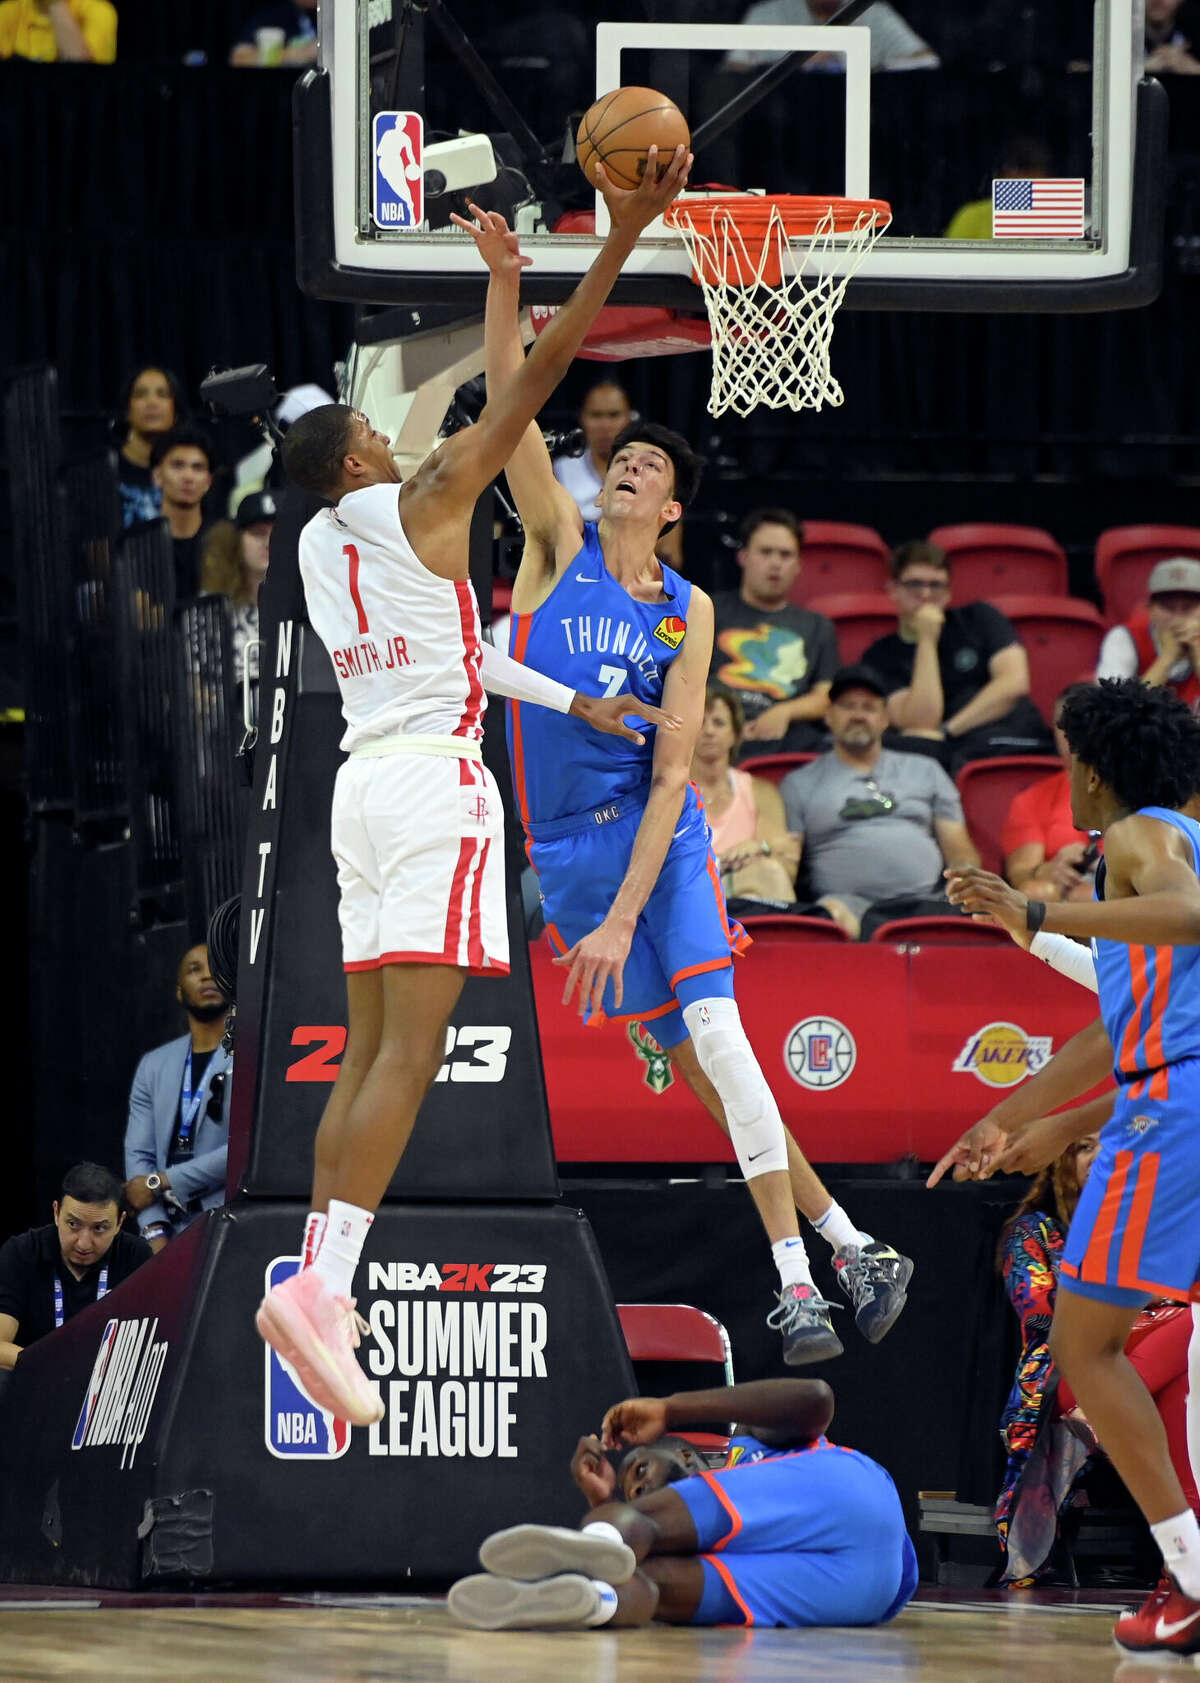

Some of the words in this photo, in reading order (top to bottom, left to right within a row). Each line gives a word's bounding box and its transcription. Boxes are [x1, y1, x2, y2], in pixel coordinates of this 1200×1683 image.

[381, 202, 406, 222] NBA
[342, 543, 370, 635] 1
[333, 641, 383, 679] SMITH
[385, 636, 417, 670] JR.
[598, 664, 628, 699] 7
[261, 620, 293, 811] NBA
[594, 805, 620, 825] OKC
[249, 842, 272, 965] TV
[285, 1025, 512, 1083] 23
[368, 1299, 548, 1378] SUMMER
[85, 1317, 150, 1447] NBA
[276, 1411, 318, 1445] NBA
[368, 1380, 518, 1458] LEAGUE
